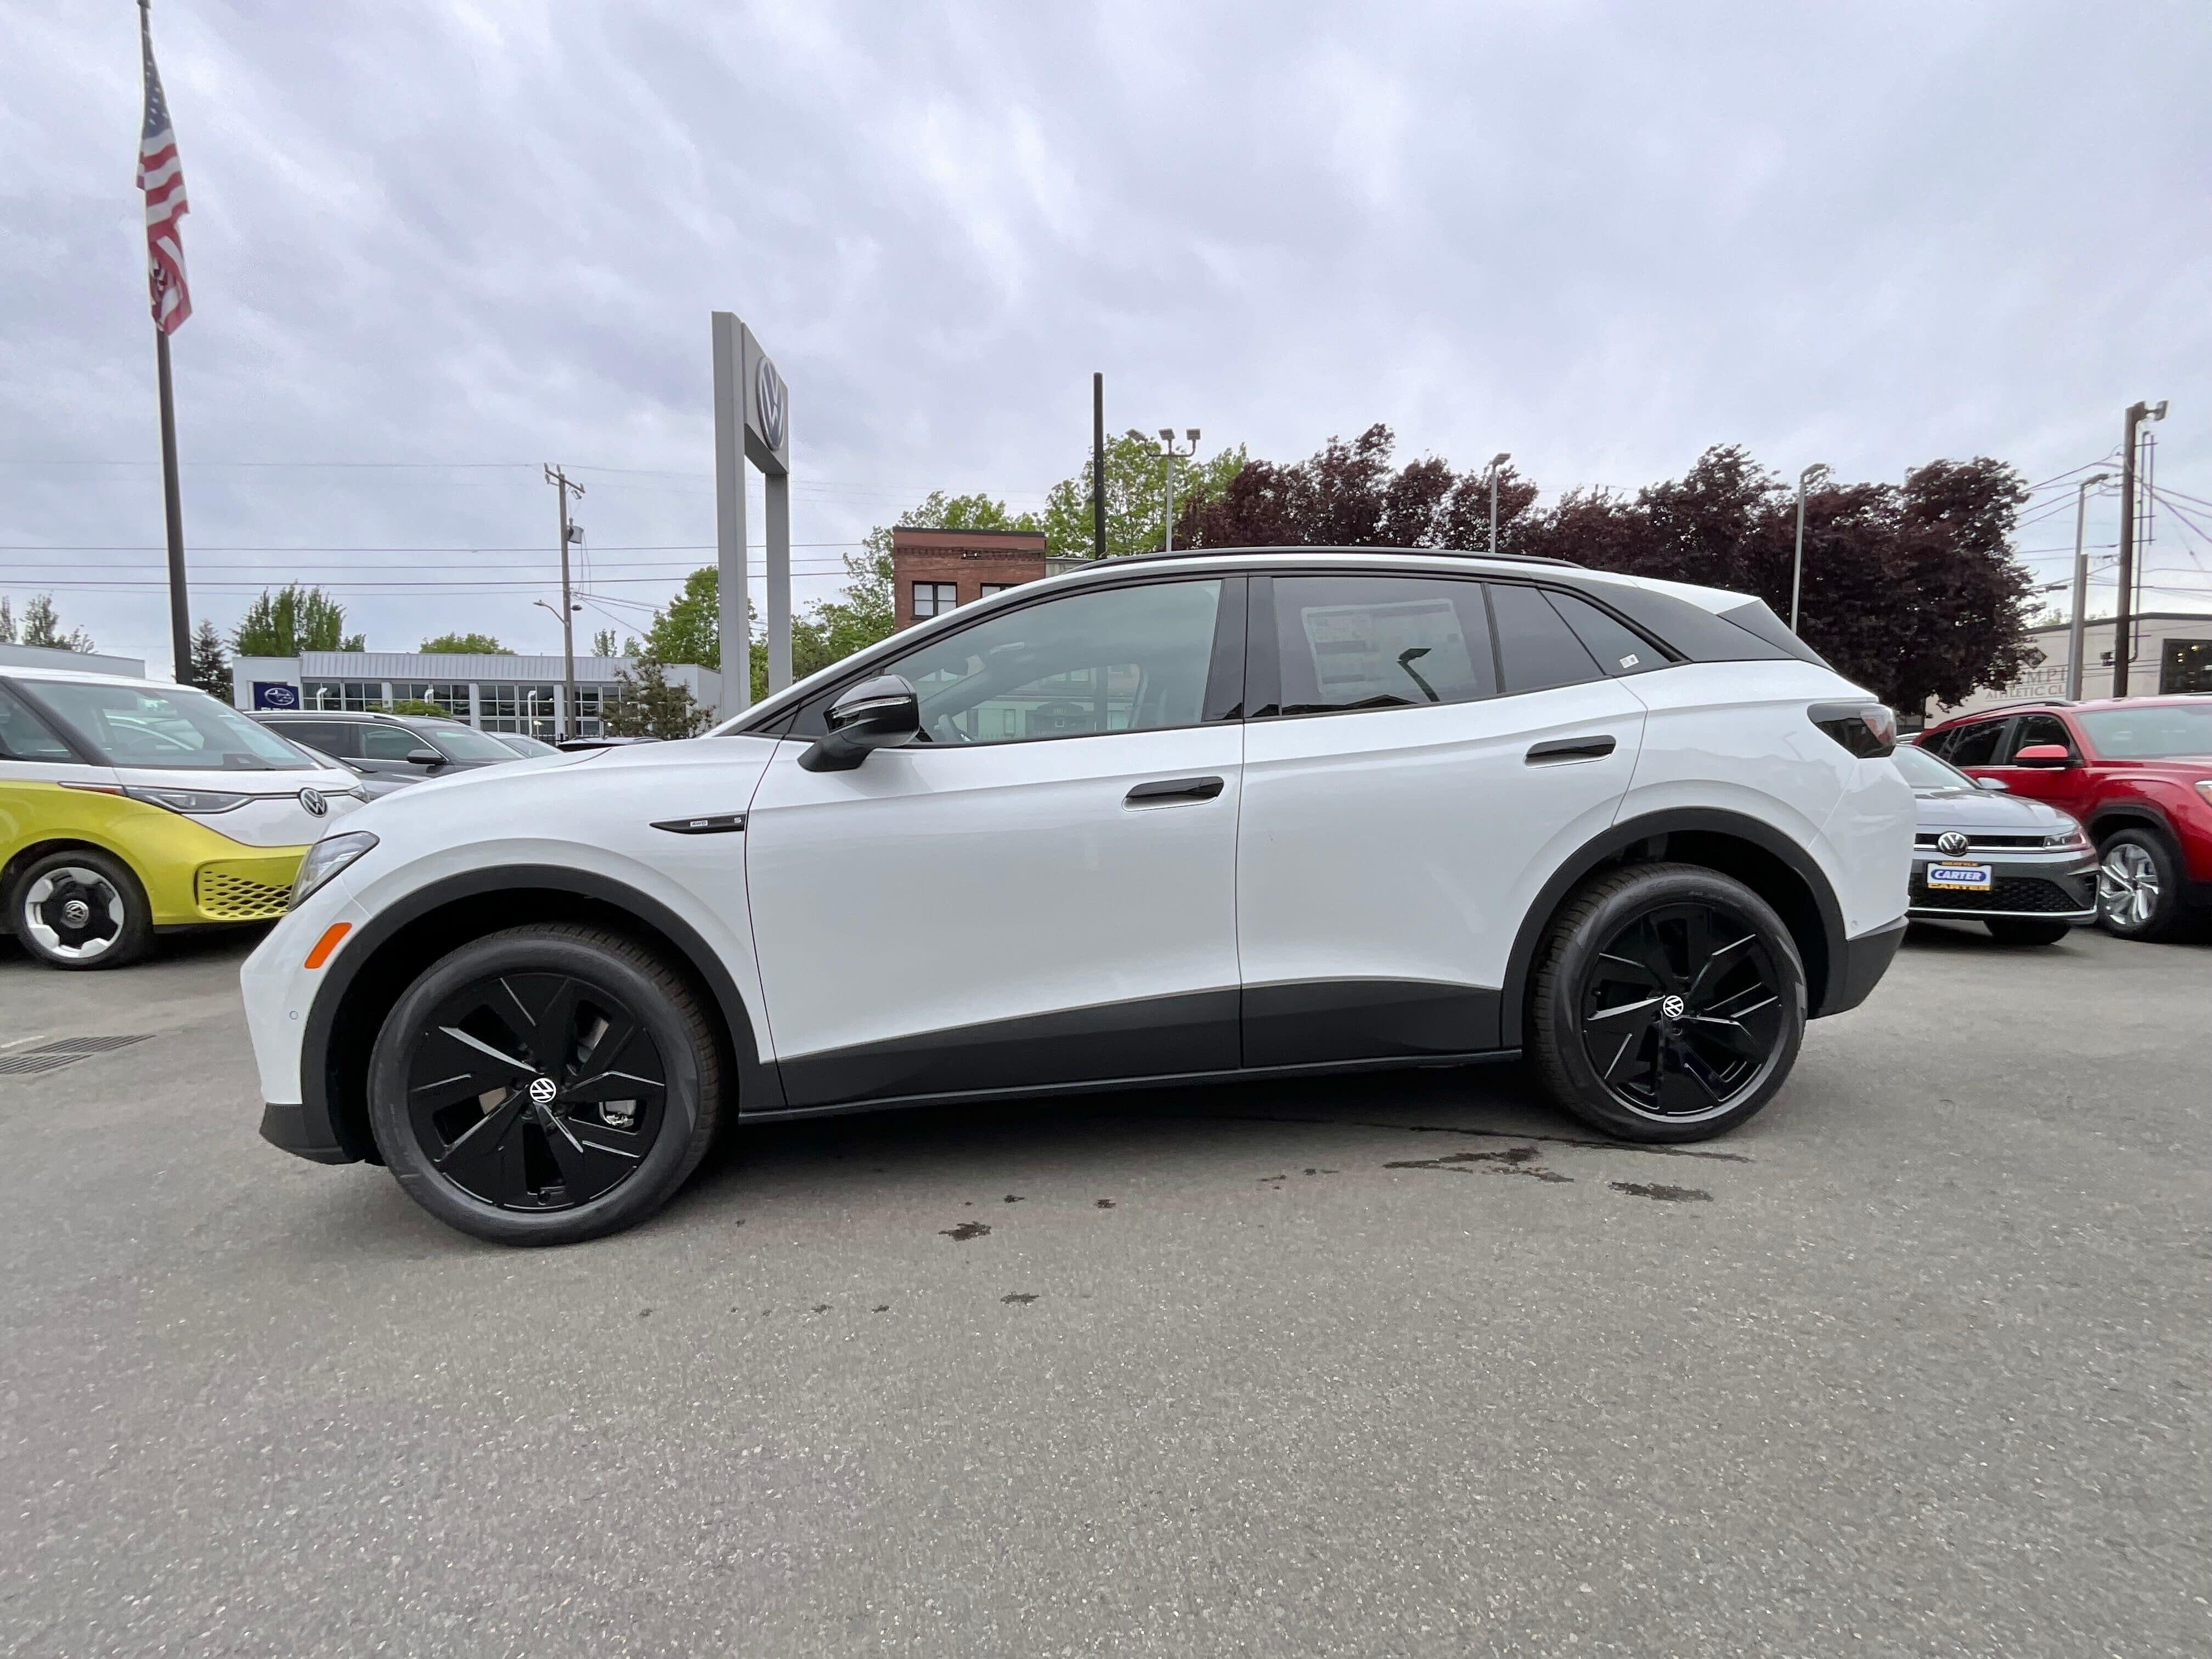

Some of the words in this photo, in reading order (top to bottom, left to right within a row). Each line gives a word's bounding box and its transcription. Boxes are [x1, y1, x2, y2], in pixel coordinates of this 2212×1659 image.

[301, 788, 327, 817] VW
[1934, 870, 1982, 881] CARTER
[1663, 996, 1684, 1017] VW
[530, 1078, 556, 1103] VW
